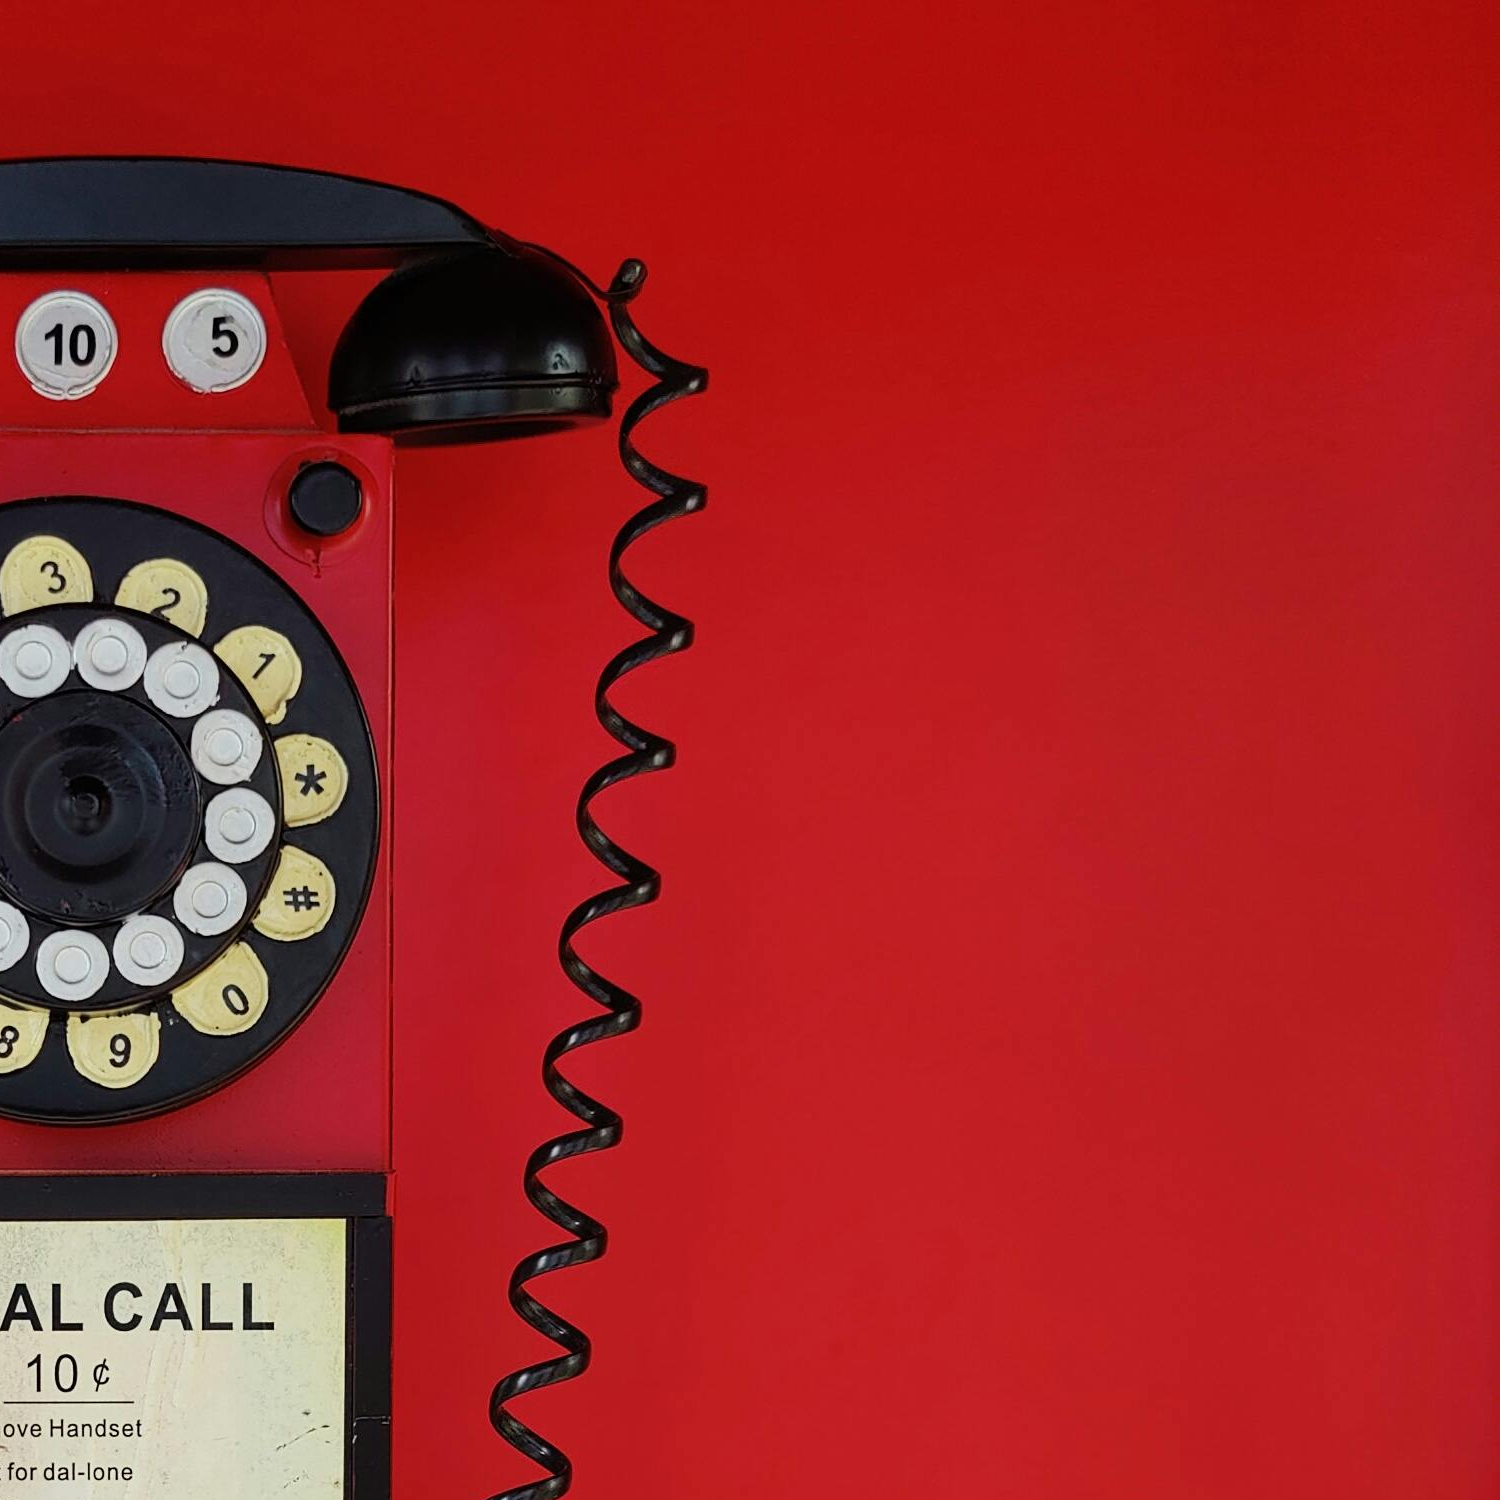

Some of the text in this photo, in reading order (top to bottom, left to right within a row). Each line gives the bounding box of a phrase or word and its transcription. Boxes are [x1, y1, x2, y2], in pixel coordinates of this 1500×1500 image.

[45, 324, 96, 366] 10
[212, 317, 238, 357] 5
[41, 562, 66, 593] 3
[152, 588, 181, 619] 2
[253, 654, 275, 679] 1
[223, 985, 249, 1015] 0
[110, 1034, 131, 1067] 9
[104, 1282, 274, 1331] CALL
[50, 1419, 141, 1437] Handset
[8, 1462, 37, 1481] for
[44, 1463, 132, 1480] dal-lone
